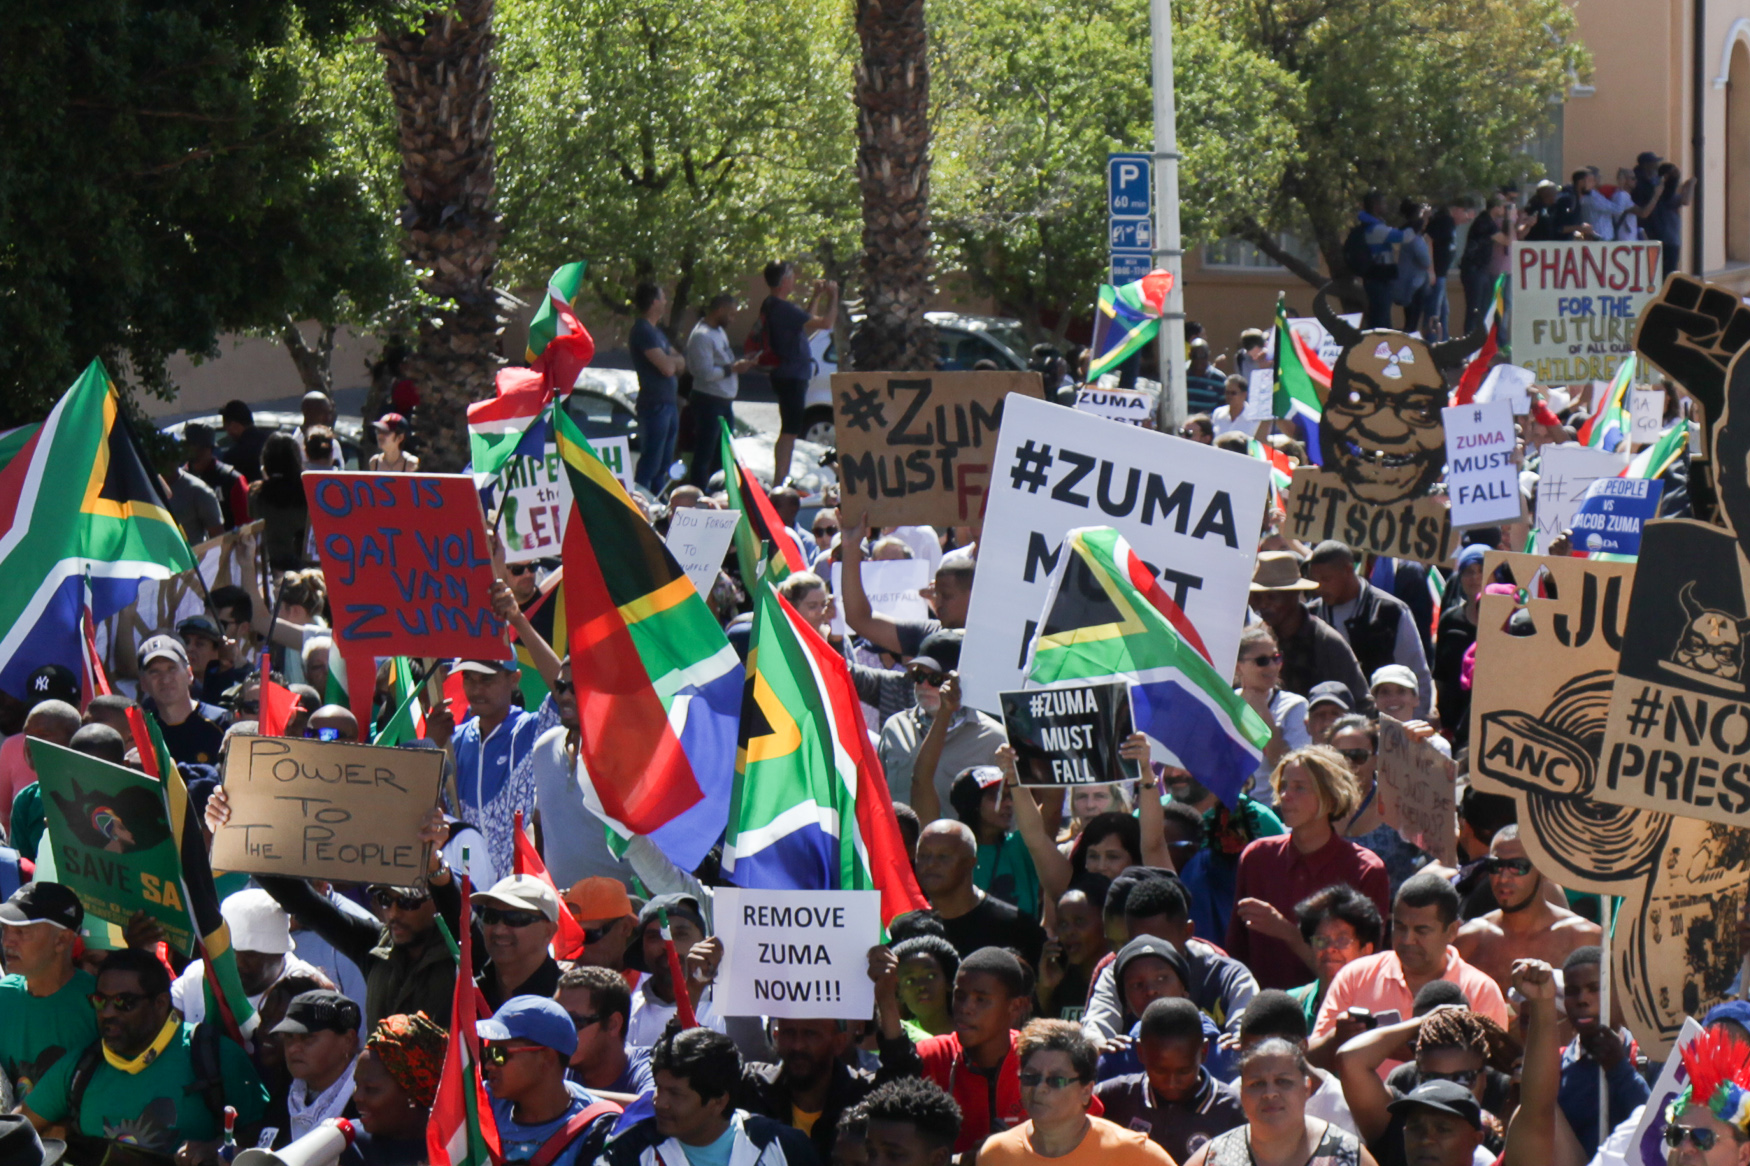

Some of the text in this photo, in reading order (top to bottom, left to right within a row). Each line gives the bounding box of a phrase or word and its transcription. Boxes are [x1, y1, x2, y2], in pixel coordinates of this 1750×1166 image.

[1119, 164, 1140, 190] P
[1113, 195, 1129, 208] 60
[1519, 245, 1662, 294] PHANSI!
[1558, 295, 1636, 318] FOR THE
[1532, 316, 1638, 345] FUTURE
[839, 378, 1001, 449] #ZUM
[1079, 392, 1146, 410] ZUMA
[1456, 430, 1506, 450] ZUMA
[840, 449, 959, 501] MUST
[1453, 451, 1512, 475] MUST
[410, 479, 444, 509] IS
[1009, 439, 1240, 550] #ZUMA
[1458, 479, 1513, 505] FALL
[1604, 480, 1648, 497] PEOPLE
[675, 510, 736, 530] YOU FORGOT
[1571, 511, 1608, 530] JACOB
[1609, 516, 1641, 534] ZUMA
[414, 528, 491, 571] VOL
[683, 544, 698, 557] TO
[391, 568, 469, 607] VAN
[1029, 688, 1099, 718] #ZUMA
[1041, 724, 1093, 752] MUST
[248, 740, 409, 793] POWER
[1052, 758, 1096, 783] FALL
[1484, 732, 1571, 788] ANC
[274, 795, 352, 824] TO
[224, 824, 420, 869] THE PEOPLE
[63, 845, 184, 912] SAVE SA
[743, 905, 846, 928] REMOVE
[758, 943, 832, 965] ZUMA
[754, 979, 842, 1002] NOW!!!
